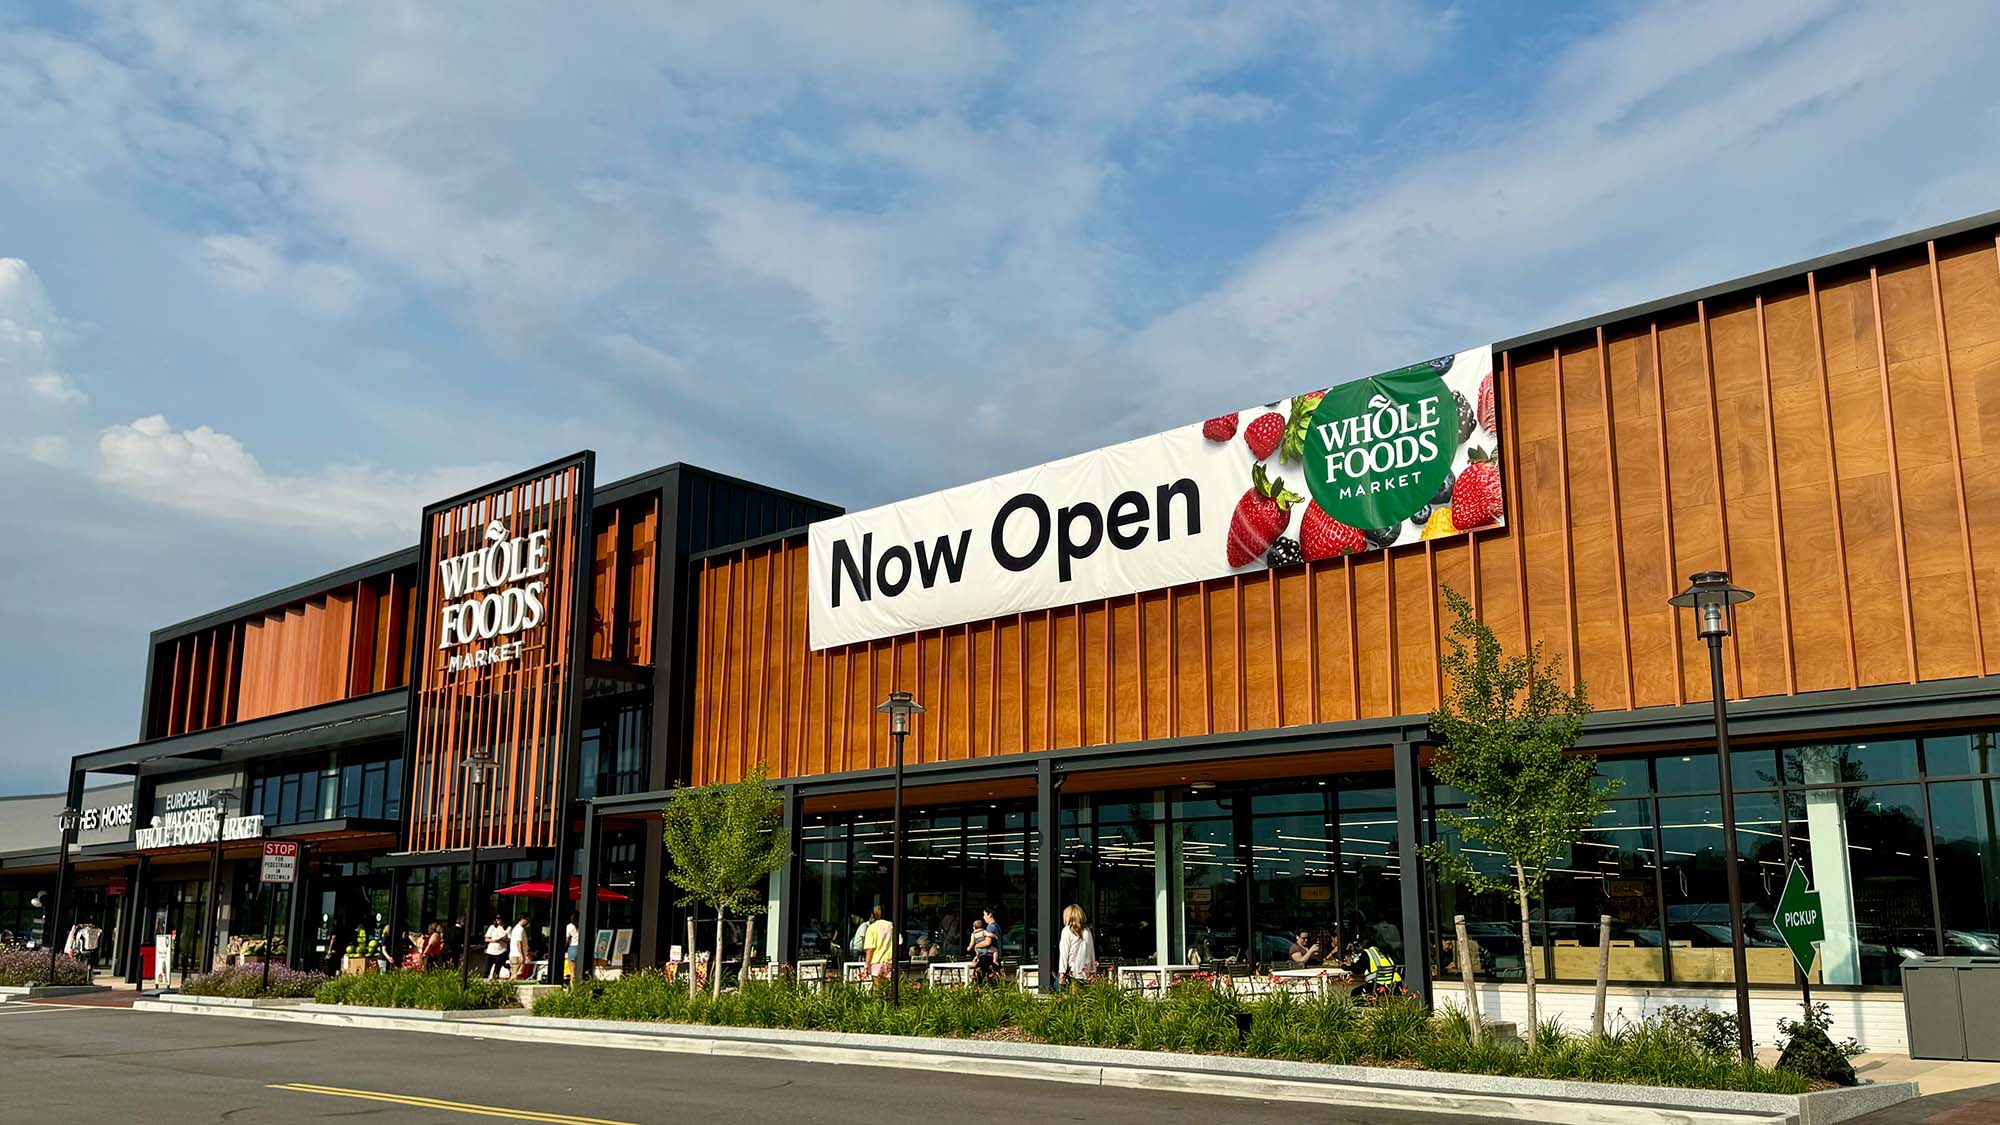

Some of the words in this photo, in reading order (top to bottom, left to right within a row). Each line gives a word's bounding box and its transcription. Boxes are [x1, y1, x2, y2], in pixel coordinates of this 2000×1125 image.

[1316, 396, 1440, 452] WHOLE
[1324, 429, 1439, 484] FOODS
[1339, 471, 1422, 500] MARKET
[832, 529, 973, 608] Now
[991, 477, 1201, 583] Open
[439, 529, 550, 600] WHOLE
[439, 581, 545, 649] FOODS
[448, 640, 525, 673] MARKET
[166, 789, 209, 810] EUROPEAN
[101, 803, 133, 827] HORSE
[165, 811, 183, 827] WAX
[184, 807, 216, 825] CENTER
[135, 826, 171, 850] WHOLE
[172, 823, 210, 845] FOODS
[266, 843, 296, 855] STOP
[1784, 909, 1817, 928] PICKUP
